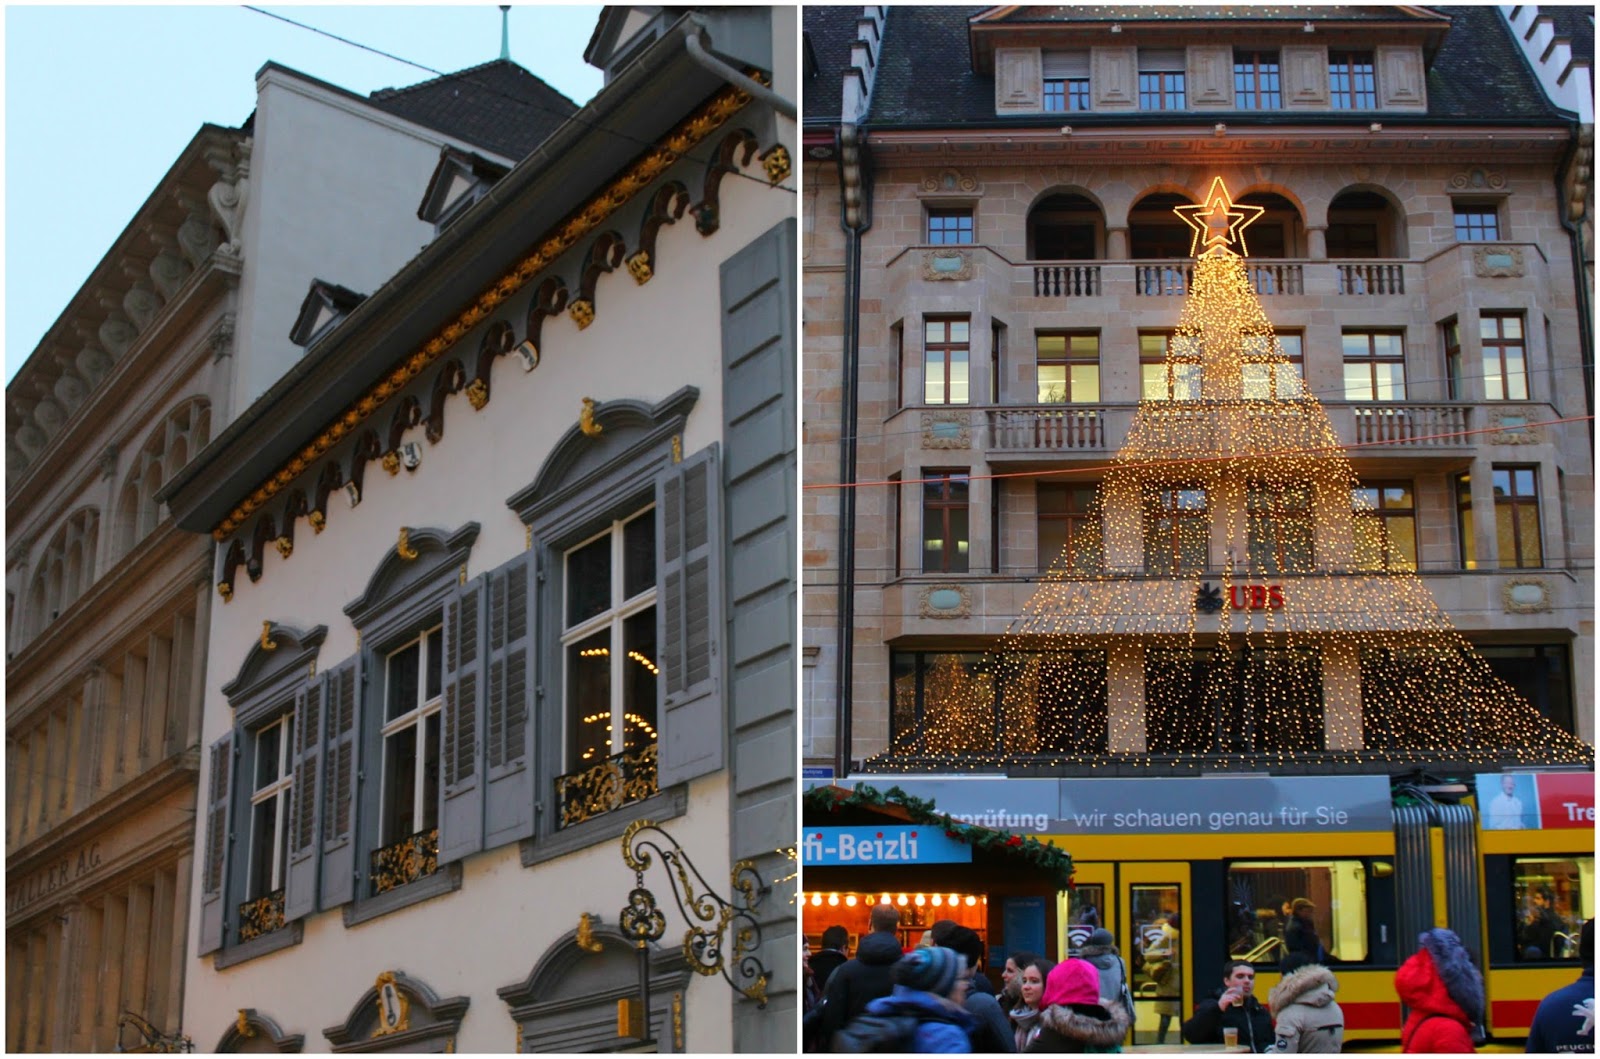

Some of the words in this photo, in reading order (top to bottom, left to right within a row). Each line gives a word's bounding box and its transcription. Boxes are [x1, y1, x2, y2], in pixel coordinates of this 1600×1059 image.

[1229, 585, 1285, 609] UBS
[931, 808, 1048, 831] prüfung
[1073, 808, 1107, 827] wir
[1113, 808, 1201, 827] schauen
[1208, 811, 1273, 830] genau
[1279, 806, 1309, 826] für
[1315, 805, 1349, 825] Sie
[1562, 802, 1595, 821] Tre
[803, 831, 918, 861] fi-Beizli
